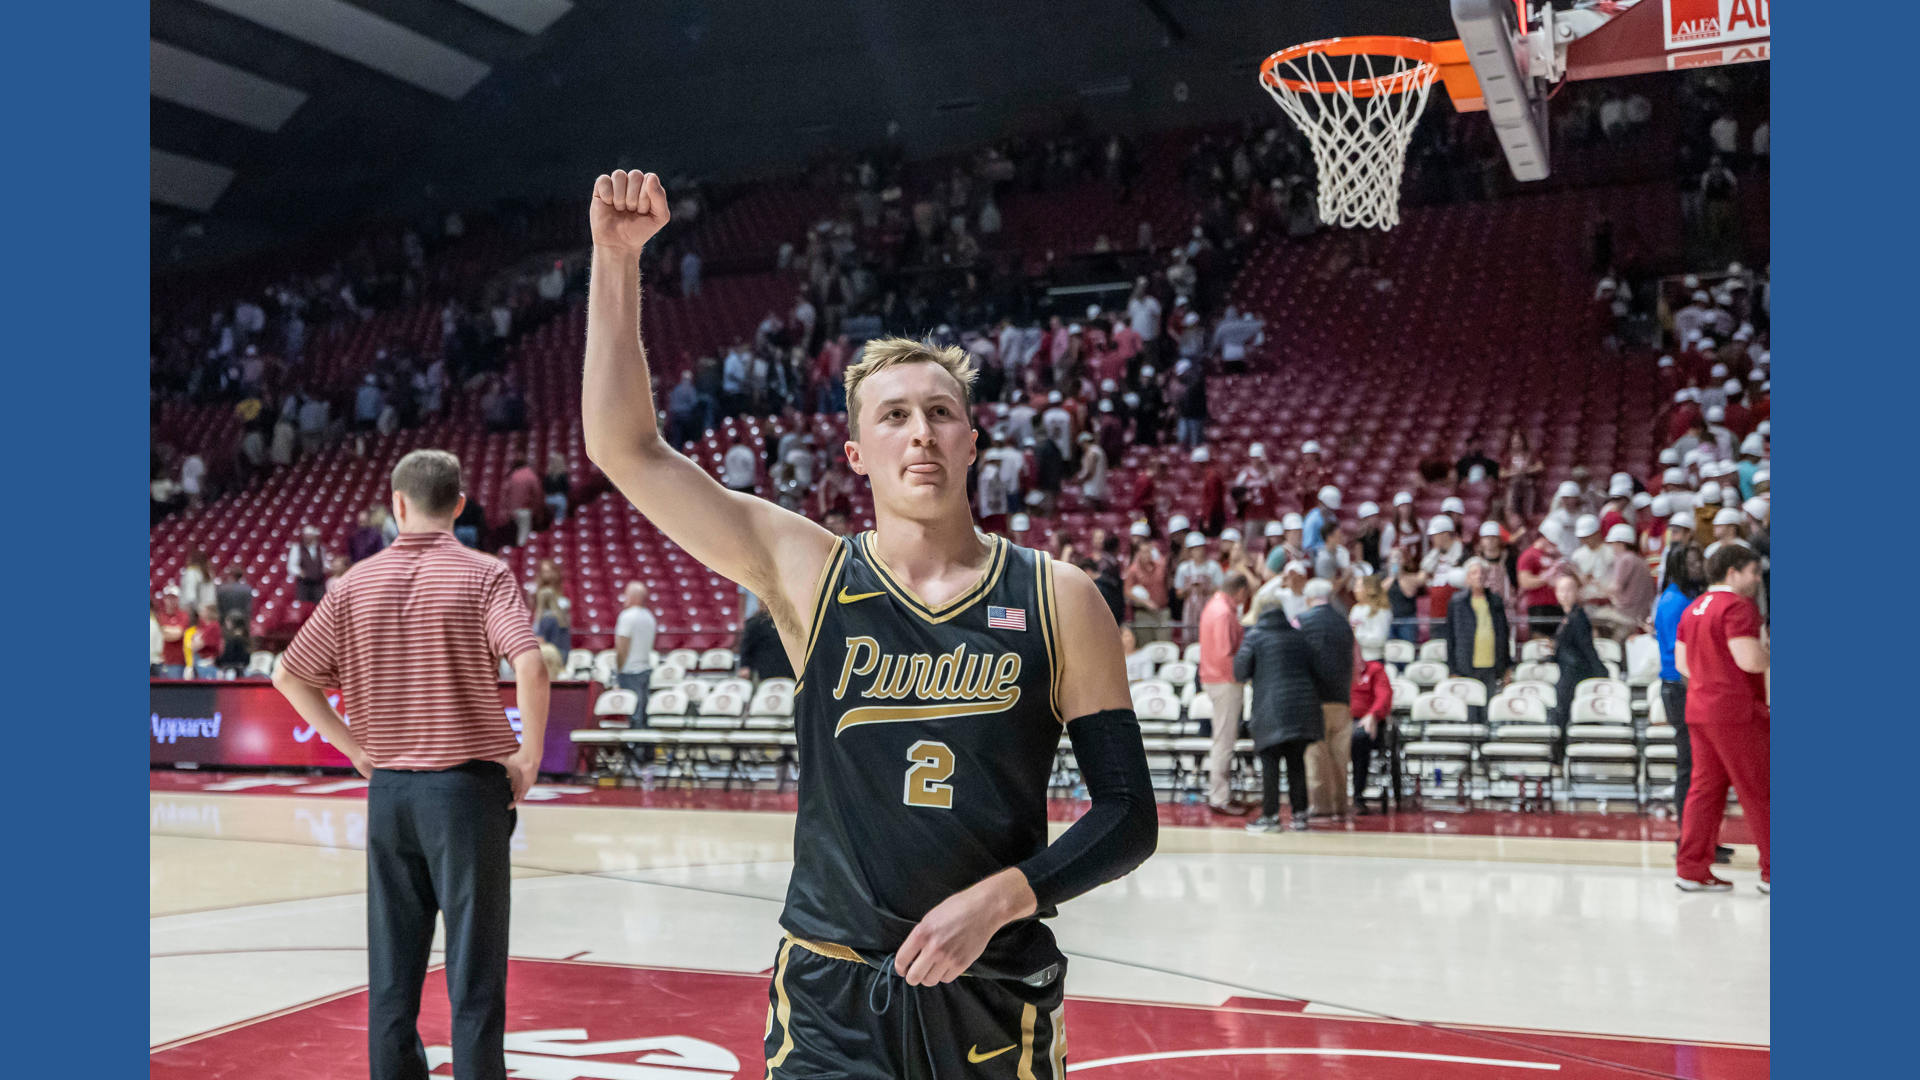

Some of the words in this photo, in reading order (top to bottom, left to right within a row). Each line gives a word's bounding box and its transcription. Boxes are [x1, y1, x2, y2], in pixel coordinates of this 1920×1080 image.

[1677, 17, 1719, 35] ALFA
[833, 636, 1021, 703] Purdue
[903, 739, 955, 809] 2
